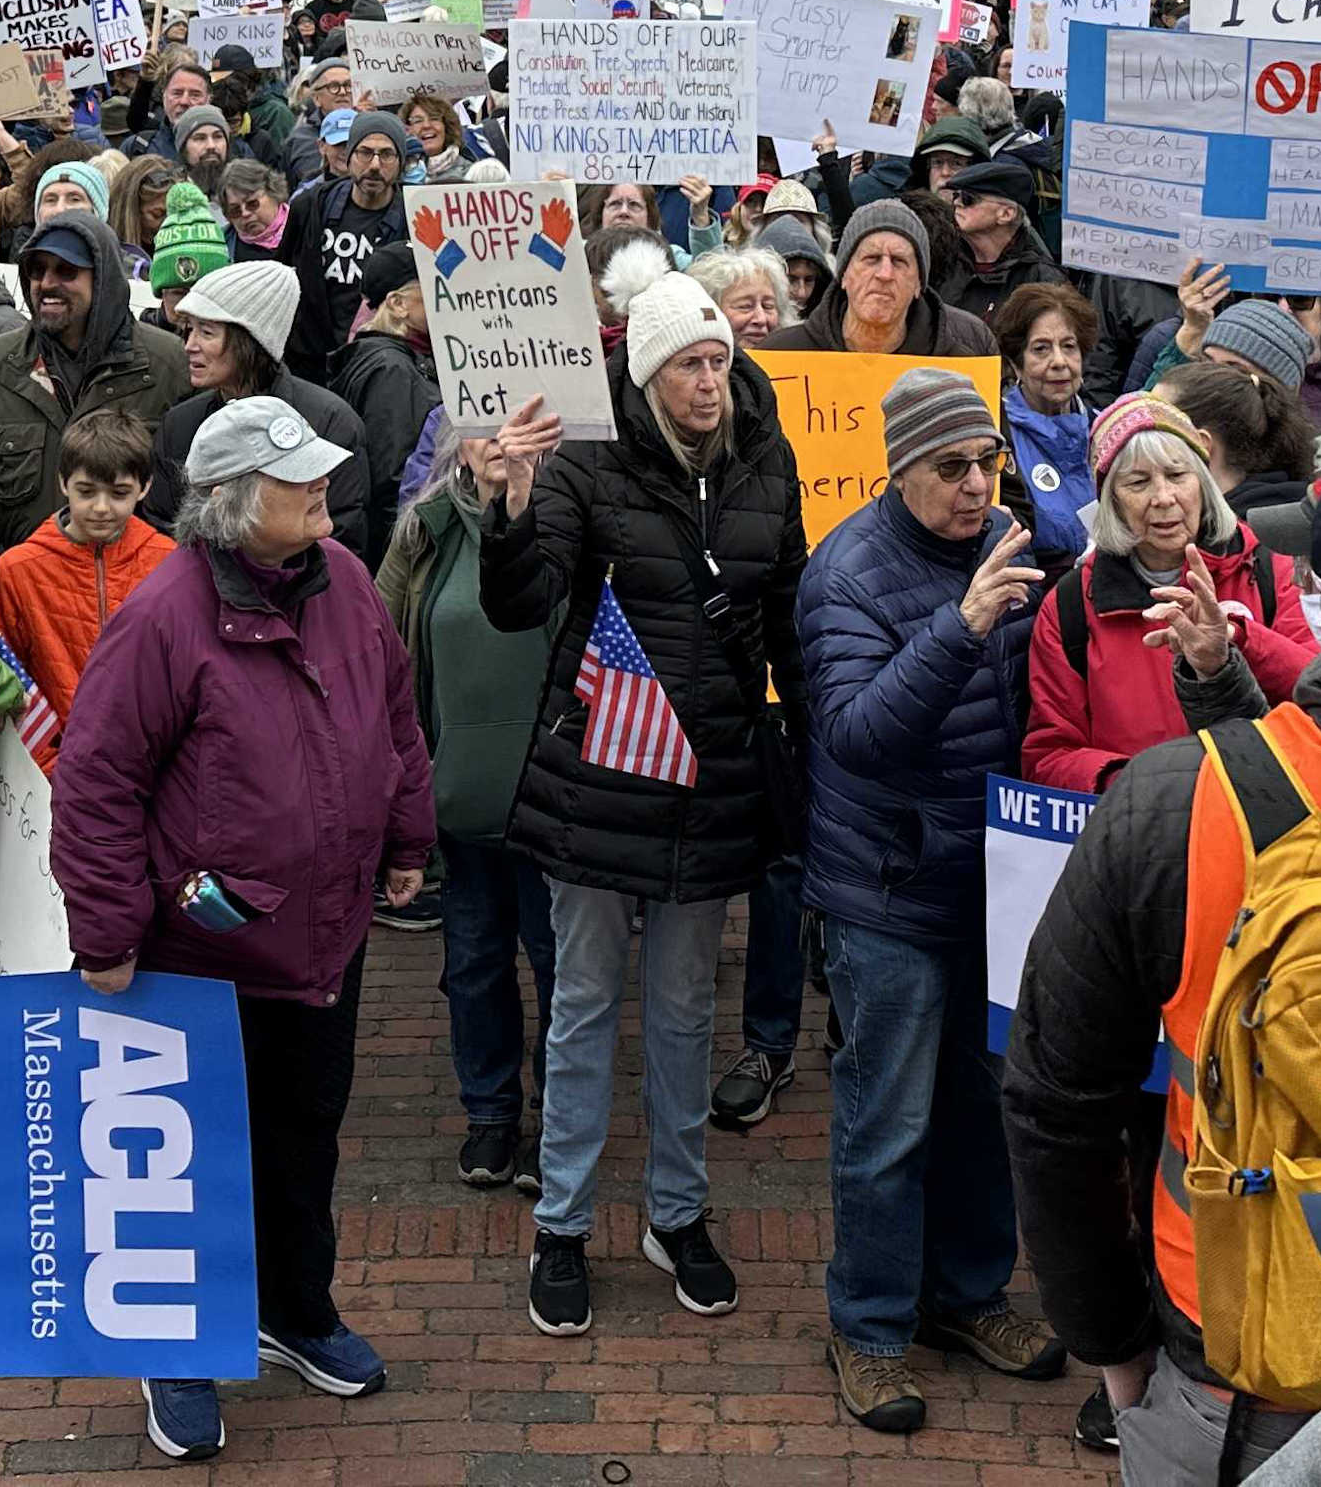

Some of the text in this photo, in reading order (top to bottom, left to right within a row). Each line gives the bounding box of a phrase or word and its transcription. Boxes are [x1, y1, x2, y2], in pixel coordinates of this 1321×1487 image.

[7, 13, 68, 38] MAKES
[541, 23, 619, 47] HANDS
[637, 24, 674, 46] OFF
[763, 15, 851, 62] Smarter
[593, 49, 621, 73] Free
[1120, 50, 1241, 102] HANDS
[579, 73, 613, 96] Social
[780, 58, 839, 112] Trump
[633, 101, 665, 121] AND
[669, 100, 692, 121] Our
[515, 124, 740, 154] NO KINGS IN AMERICA
[1088, 124, 1190, 151] SOCIAL
[584, 154, 657, 181] 86-47
[1077, 144, 1201, 177] SECURITY
[1077, 174, 1198, 204] NATIONAL
[443, 190, 535, 228] HANDS
[1098, 195, 1170, 222] PARKS
[154, 212, 225, 248] BOSTON
[469, 227, 521, 263] OFF
[1070, 224, 1178, 255] MEDICAID
[1181, 221, 1271, 254] USAID
[1070, 246, 1175, 277] MEDICARE
[433, 275, 559, 314] Americans
[482, 314, 514, 330] with
[444, 332, 593, 373] Disabilities
[457, 378, 509, 418] Act
[770, 373, 867, 434] This
[998, 786, 1041, 828] WE
[21, 1007, 67, 1341] Massachusetts
[78, 1005, 198, 1341] ACLU
